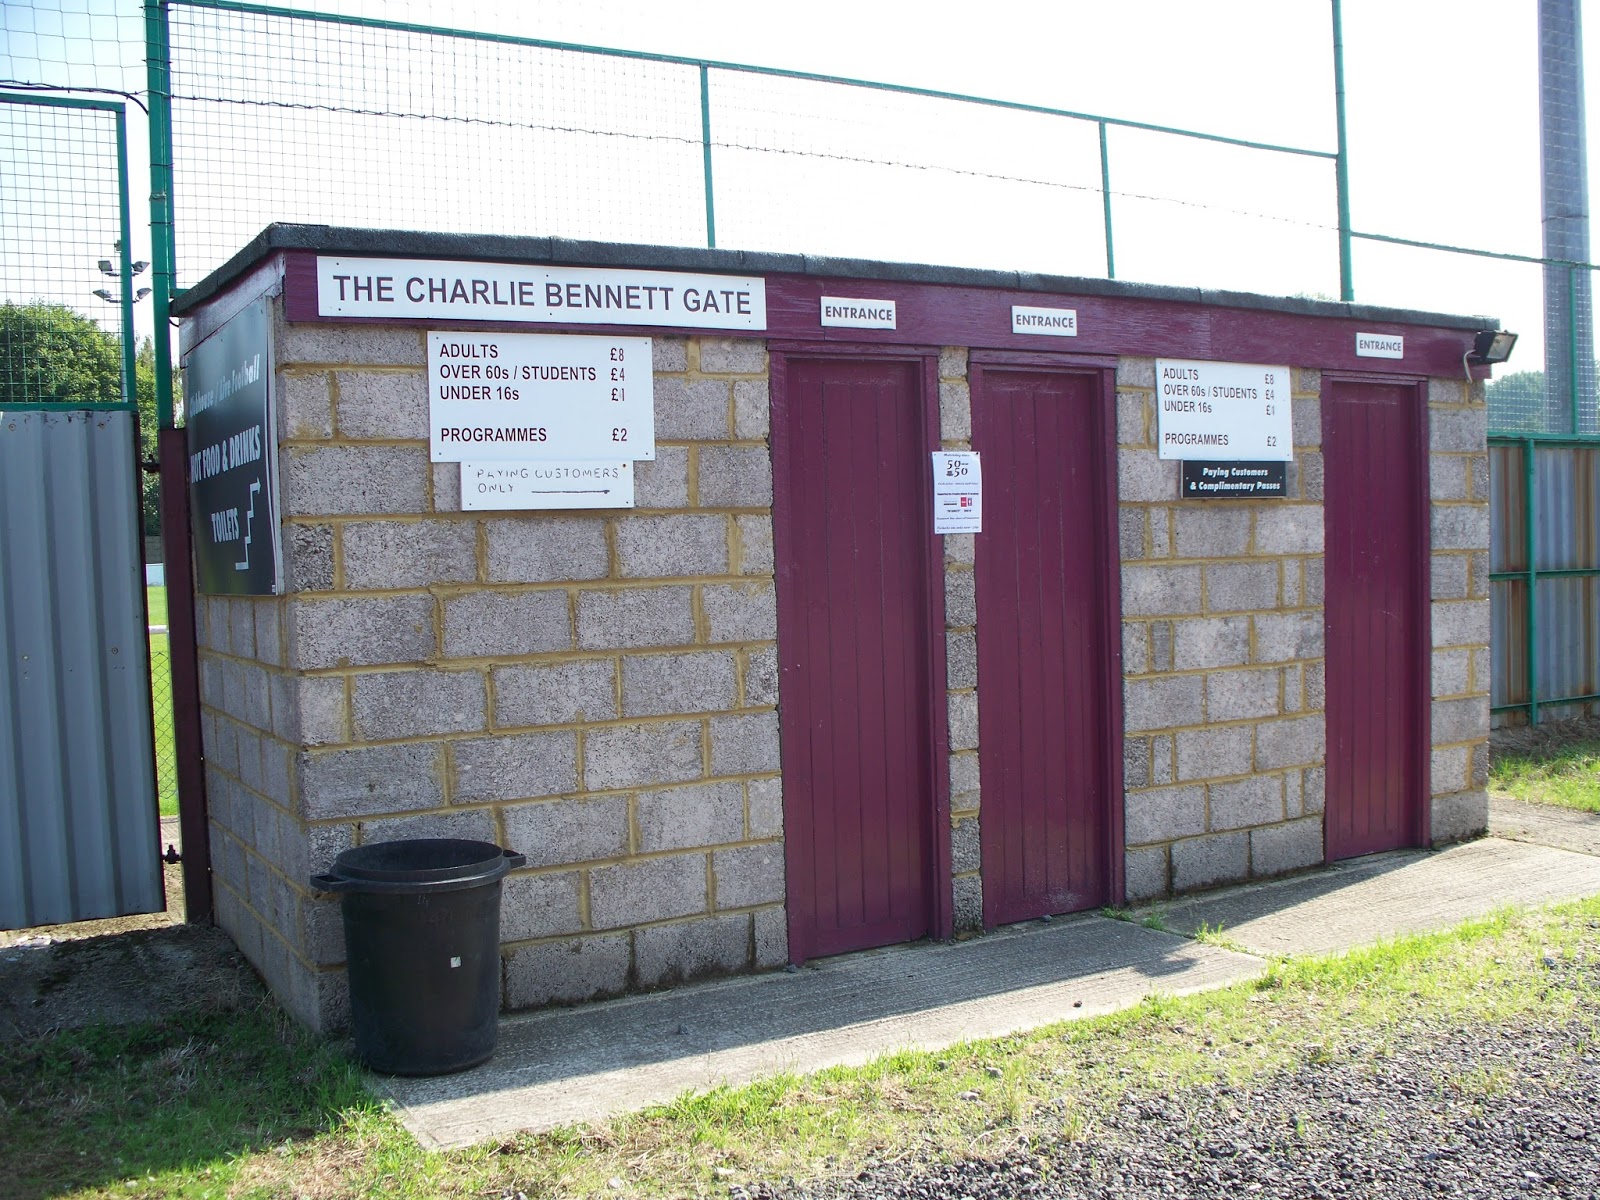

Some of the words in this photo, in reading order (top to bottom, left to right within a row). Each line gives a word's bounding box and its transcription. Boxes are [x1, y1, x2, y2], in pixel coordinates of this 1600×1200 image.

[333, 275, 394, 302] THE
[405, 277, 535, 306] CHARLIE
[545, 282, 674, 311] BENNETT
[683, 288, 751, 315] GATE
[825, 306, 892, 321] ENTRANCE
[1016, 314, 1074, 328] ENTRANCE
[440, 344, 498, 358] ADULTS
[1359, 340, 1401, 351] ENTRANCE
[610, 347, 624, 362] £8
[232, 353, 260, 394] Football
[440, 365, 481, 379] OVER
[486, 365, 509, 380] 60s
[522, 366, 596, 381] STUDENTS
[611, 367, 625, 381] £4
[1163, 368, 1199, 380] ADULTS
[440, 386, 491, 400] UNDER
[496, 386, 519, 401] 16s
[611, 388, 625, 401] £1
[1164, 384, 1188, 396] OVER
[1191, 386, 1205, 397] 60s
[1213, 387, 1257, 399] STUDENTS
[1164, 401, 1195, 412] UNDER
[1198, 402, 1212, 413] 16s
[441, 428, 547, 442] PROGRAMMES
[612, 428, 627, 442] £2
[1165, 433, 1229, 446] PROGRAMMES
[1267, 436, 1276, 447] £2
[191, 452, 202, 483] HOT
[203, 444, 220, 479] FOOD
[222, 440, 228, 472] &
[229, 424, 260, 469] DRINKS
[947, 460, 961, 470] 50
[477, 468, 529, 479] PAYING
[535, 468, 619, 479] CUSTOMERS
[954, 468, 968, 478] 50
[1202, 468, 1229, 478] Paying
[1231, 468, 1268, 476] Customers
[478, 483, 514, 493] ONLY
[1190, 482, 1197, 490] &
[1198, 482, 1255, 492] Complimentary
[1257, 482, 1280, 490] Passes
[211, 507, 239, 543] TOILETS
